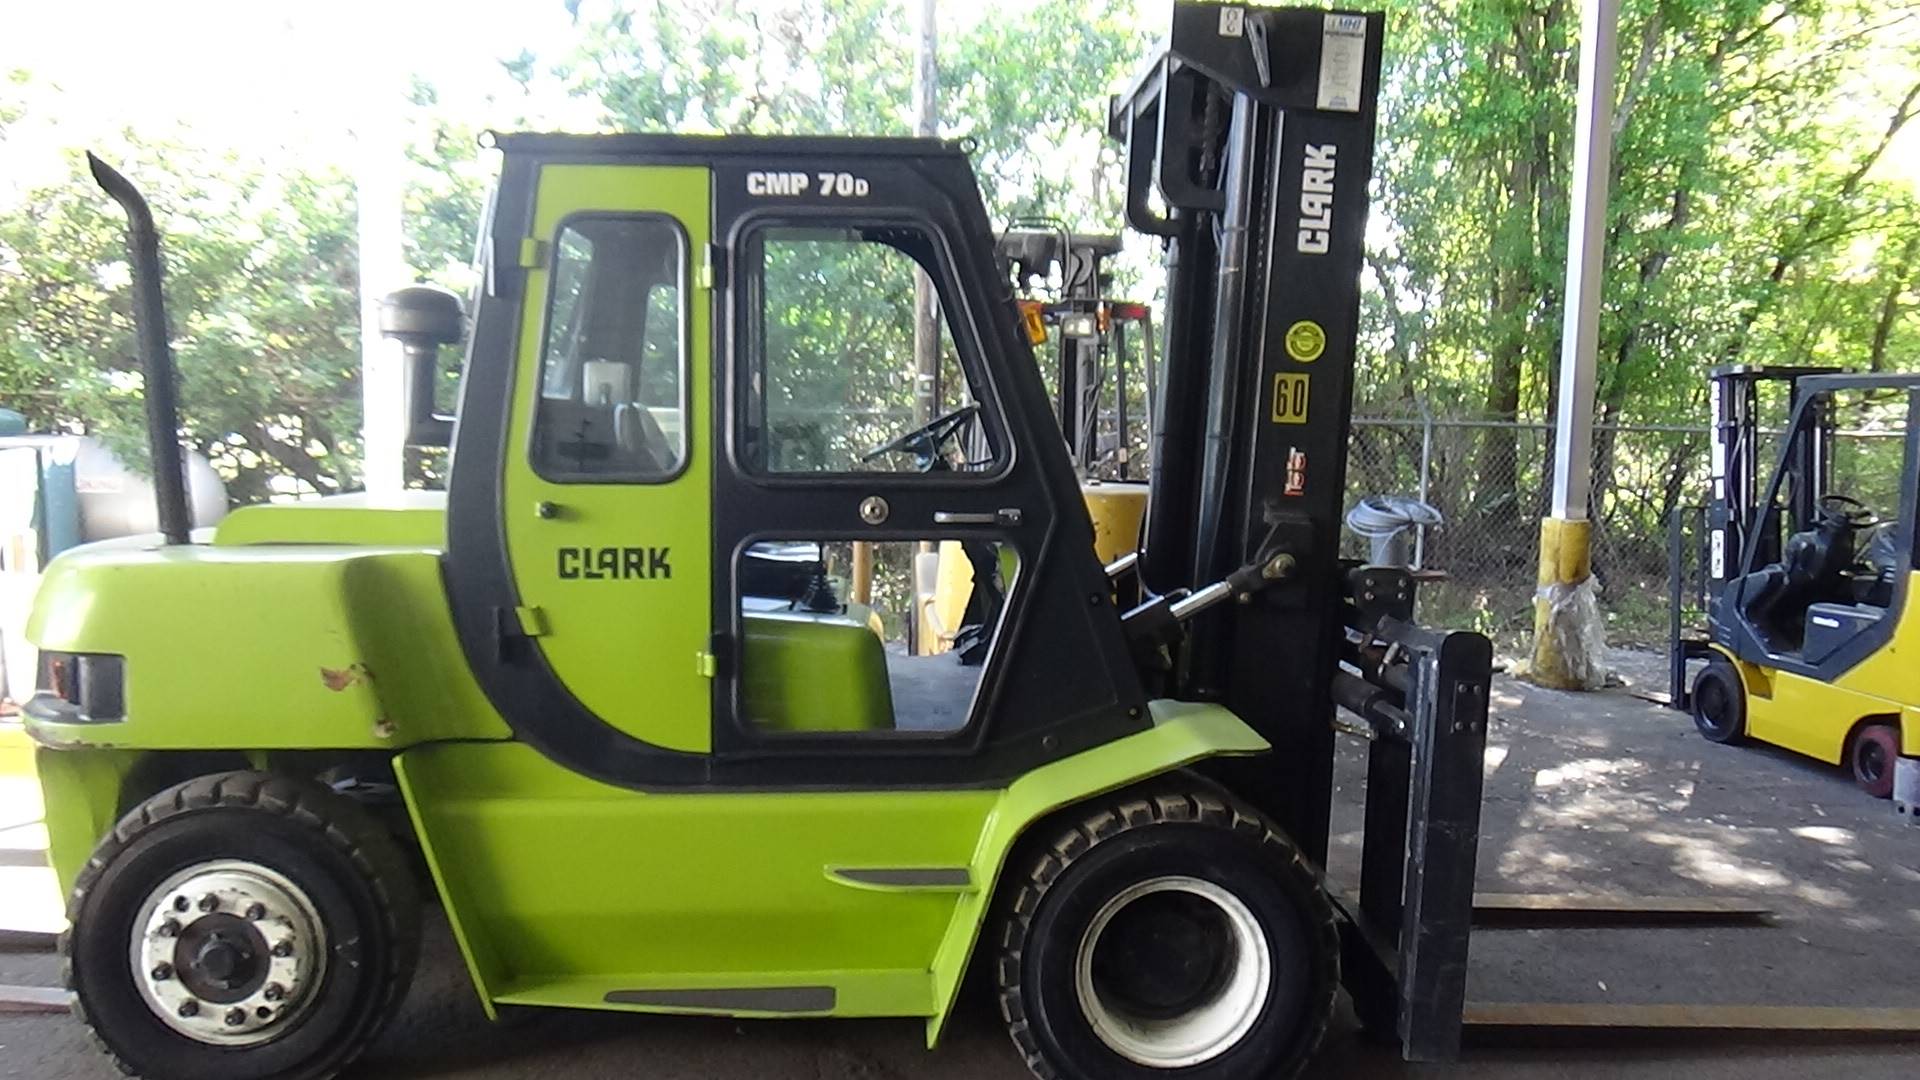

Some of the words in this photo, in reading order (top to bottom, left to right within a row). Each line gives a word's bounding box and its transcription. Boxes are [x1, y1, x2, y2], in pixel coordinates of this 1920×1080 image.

[746, 171, 809, 196] CMP
[1297, 143, 1337, 254] CLARK
[1275, 379, 1305, 417] 60
[558, 547, 671, 579] CLARK
